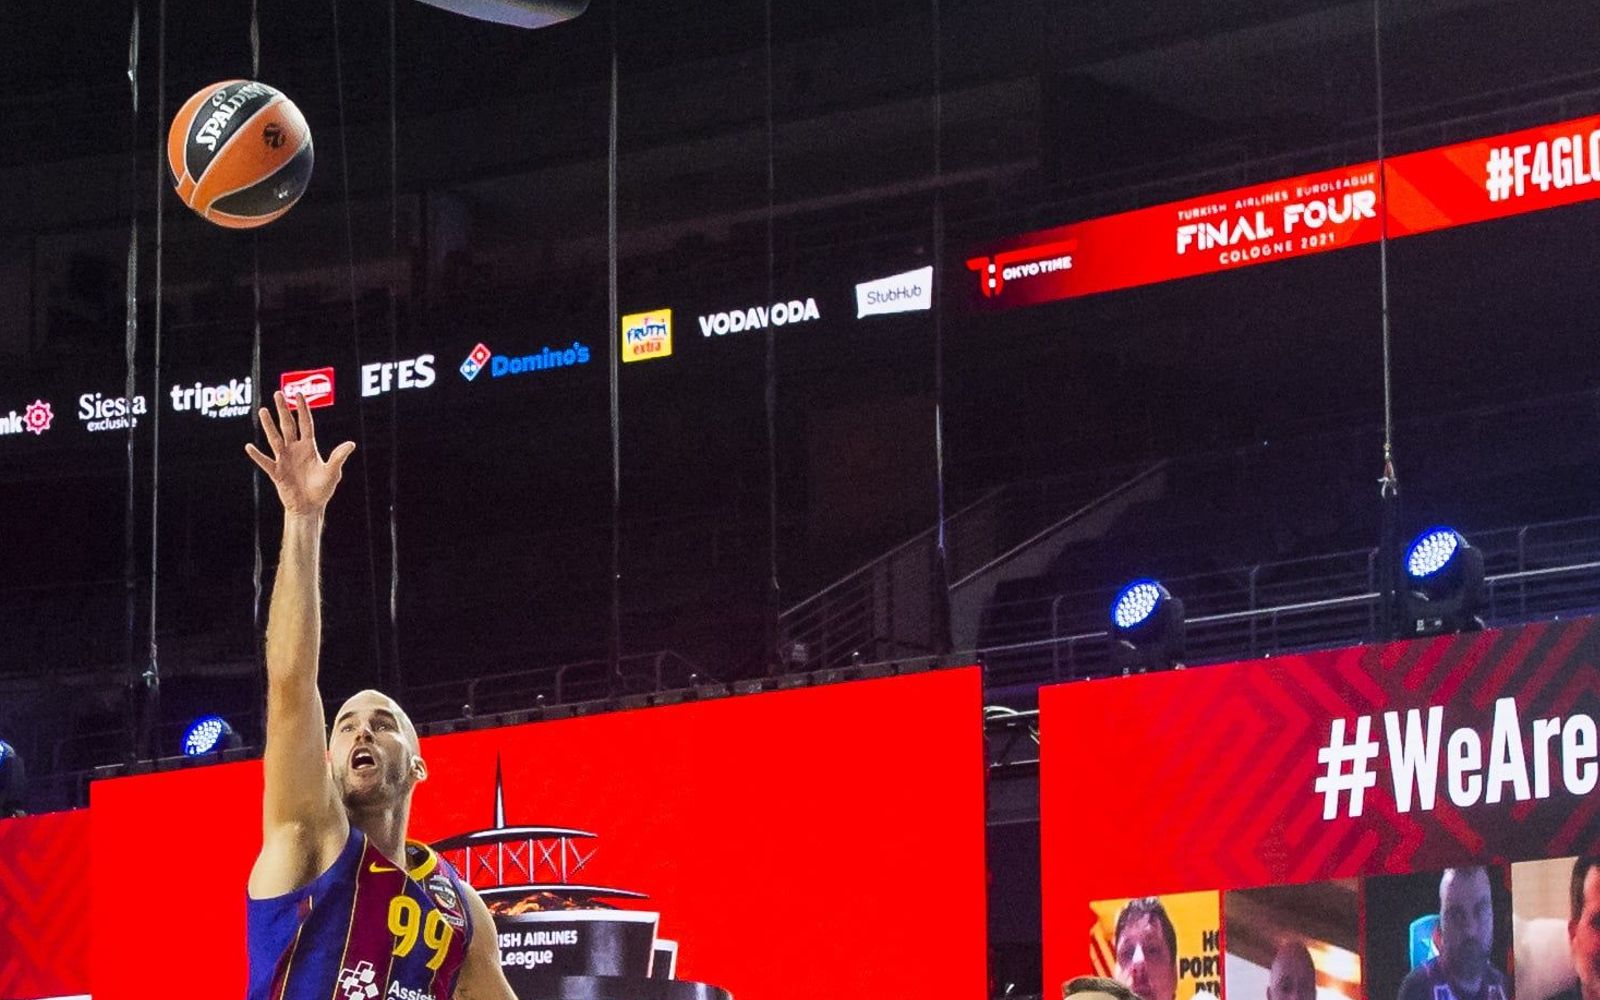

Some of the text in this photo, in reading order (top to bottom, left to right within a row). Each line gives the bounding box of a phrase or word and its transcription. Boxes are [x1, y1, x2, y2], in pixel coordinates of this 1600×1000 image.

[1178, 172, 1375, 220] TURKISH AIRLINES EUROLEAGUE
[1177, 190, 1376, 254] FINAL FOUR
[1219, 232, 1335, 265] COLOGNE 2021
[867, 285, 922, 305] StubHub
[699, 298, 819, 336] VODAVODA
[491, 341, 590, 378] Domino's
[170, 376, 252, 415] tripoki
[1315, 697, 1599, 820] #WeAre
[388, 895, 454, 970] 99
[498, 930, 578, 948] ISH AIRLINES
[499, 950, 553, 970] League
